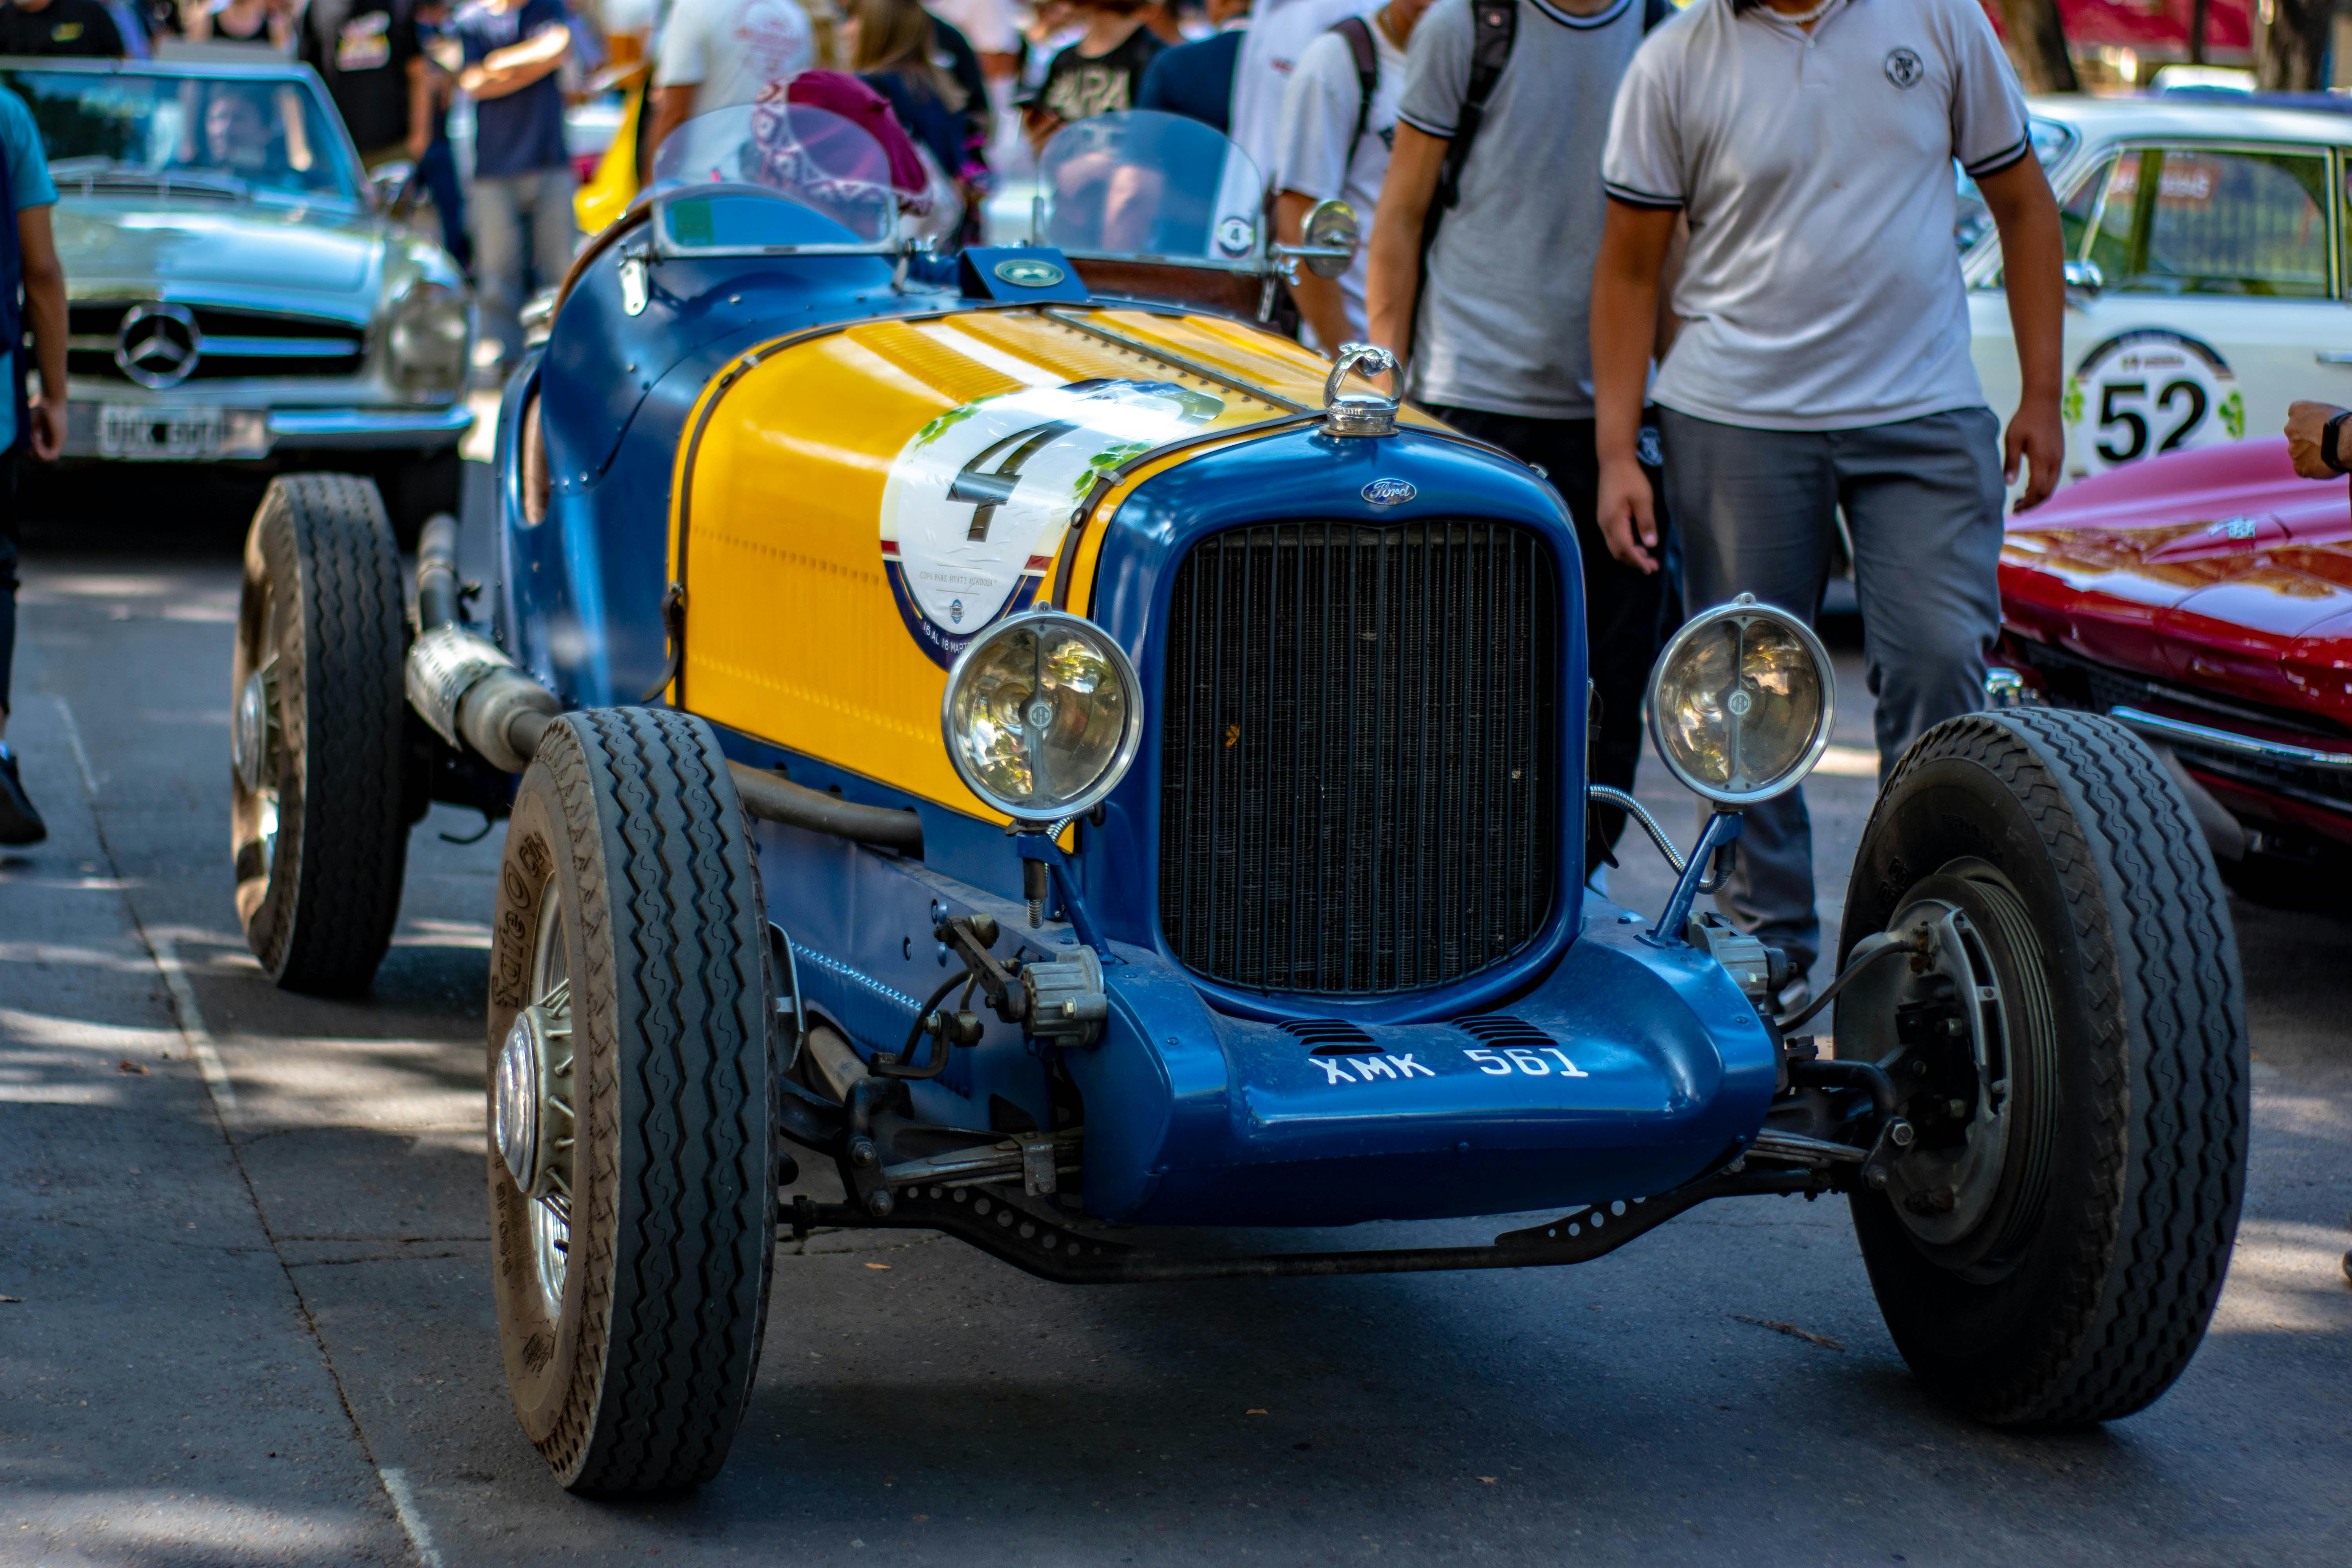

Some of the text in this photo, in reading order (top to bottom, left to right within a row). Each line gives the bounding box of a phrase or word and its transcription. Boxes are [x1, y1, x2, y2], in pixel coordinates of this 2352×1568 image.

[1230, 228, 1240, 243] 4
[2096, 380, 2207, 461] 52
[946, 419, 1083, 543] 4
[1370, 481, 1410, 499] Ford
[920, 571, 933, 581] COPA
[935, 574, 947, 583] PARK
[949, 575, 967, 584] HYATT
[924, 622, 971, 653] 16 AL 18 MARZ
[1307, 1048, 1588, 1085] XMK 561
